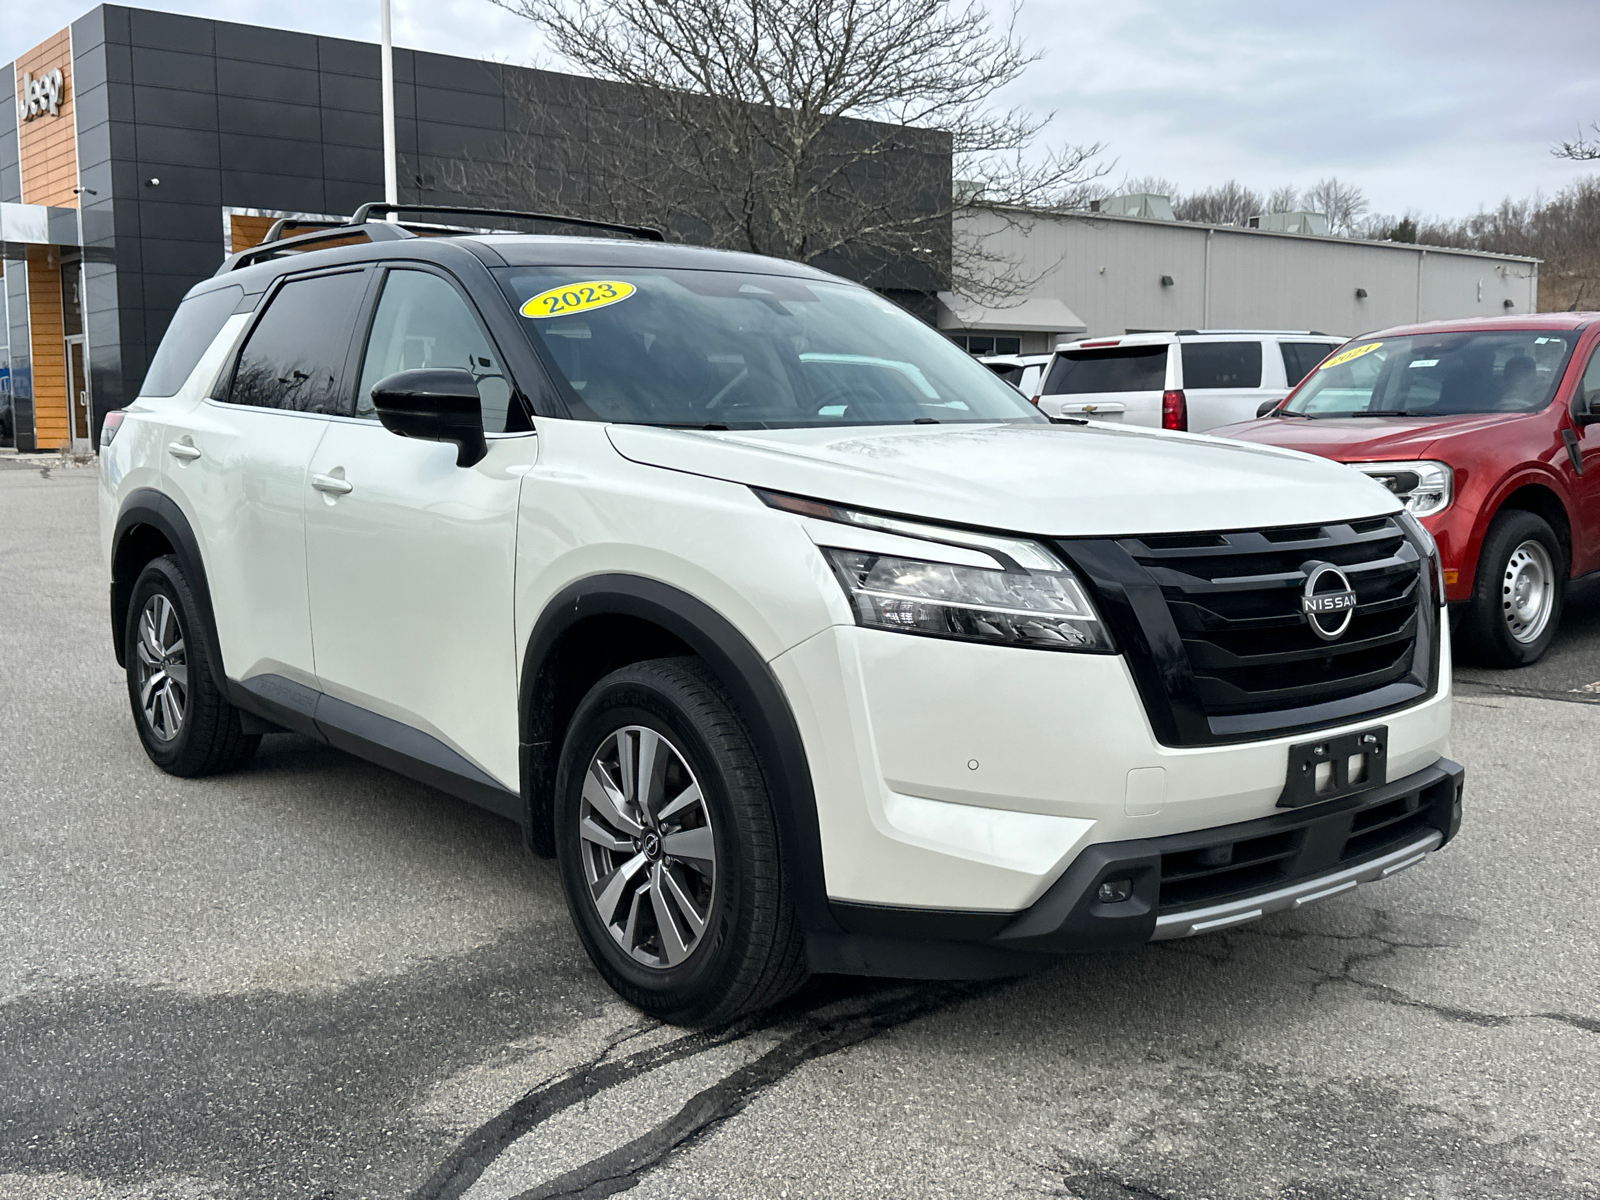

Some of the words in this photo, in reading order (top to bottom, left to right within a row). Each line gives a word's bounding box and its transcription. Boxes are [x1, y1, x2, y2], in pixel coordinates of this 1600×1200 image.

[19, 67, 62, 119] Jeep
[542, 283, 618, 314] 2023
[1304, 594, 1357, 611] NISSAN
